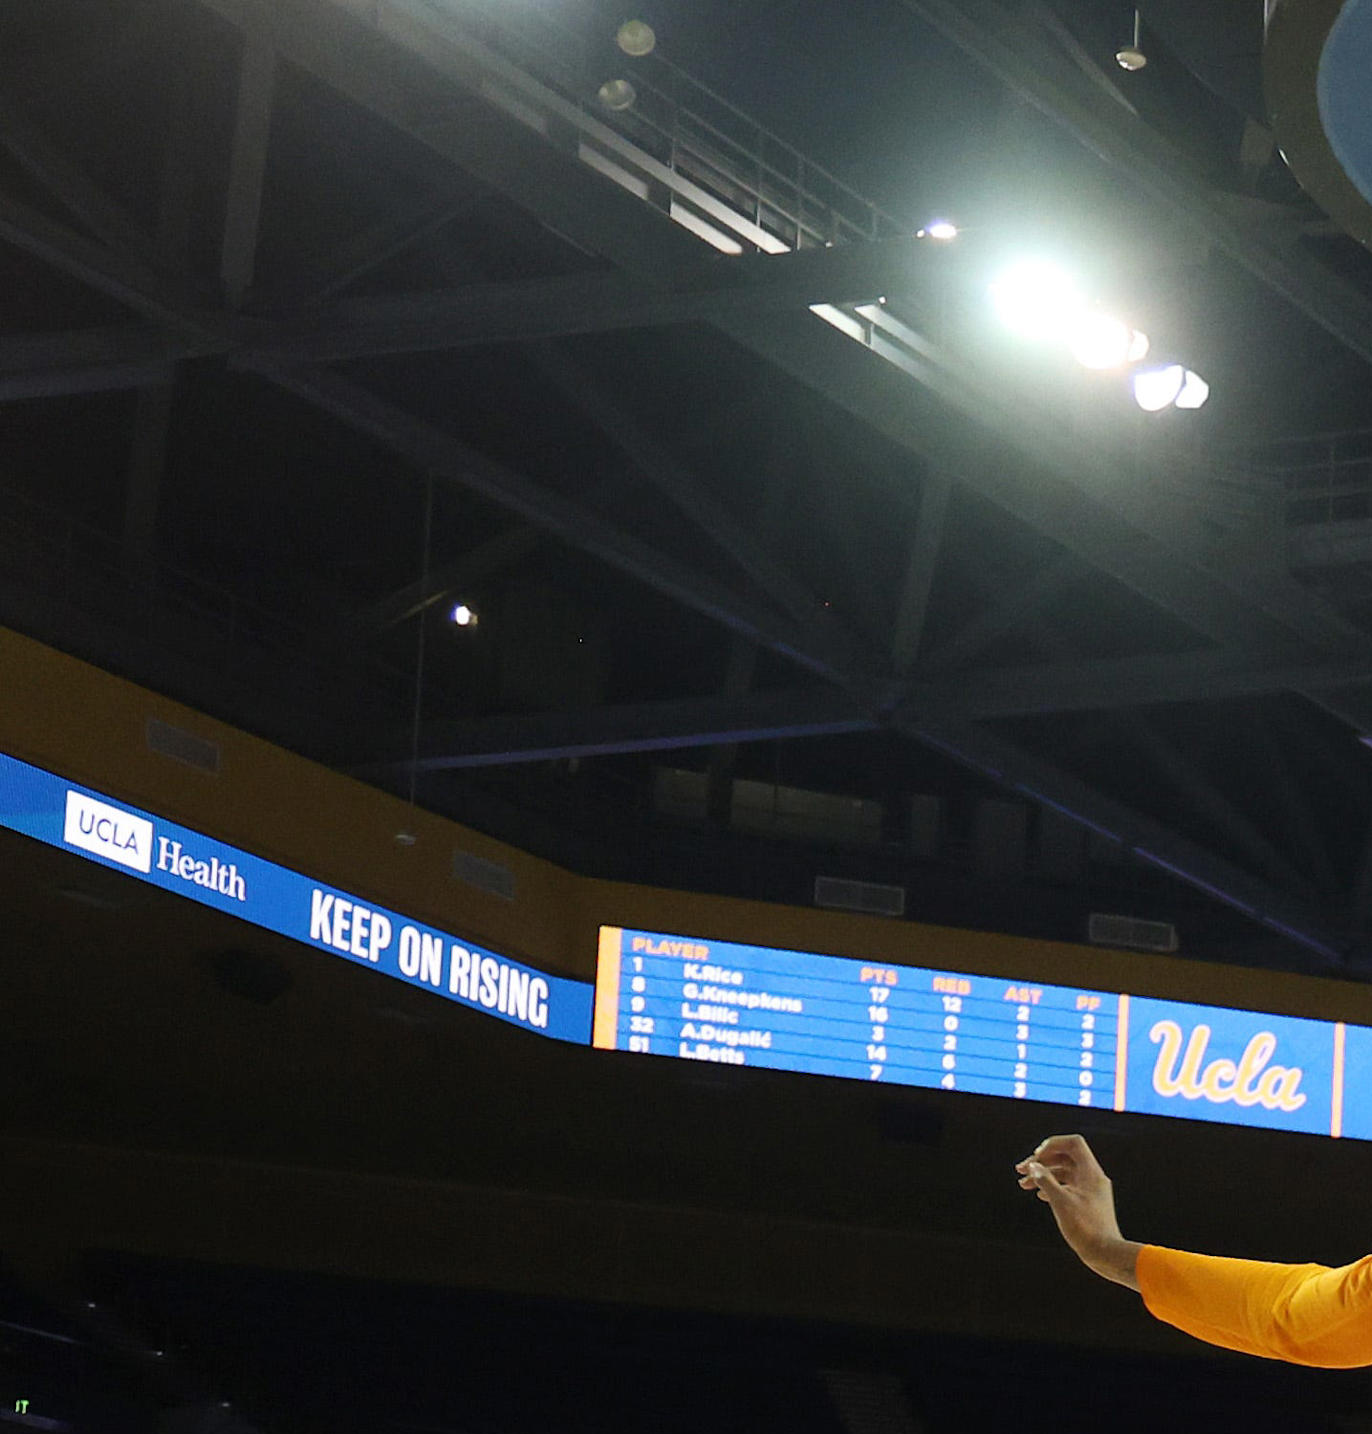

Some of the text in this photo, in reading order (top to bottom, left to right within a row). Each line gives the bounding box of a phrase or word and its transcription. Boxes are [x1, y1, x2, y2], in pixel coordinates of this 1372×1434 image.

[78, 808, 246, 901] UCLA Health
[311, 889, 548, 1028] KEEP ON RISING
[632, 937, 709, 960] PLAYER
[860, 967, 898, 985] PTS
[933, 977, 971, 995] REB
[1003, 986, 1042, 1004] AST
[633, 957, 1095, 1030] 1 K.Rice 17 12 2 2
[631, 996, 645, 1012] 9
[872, 1026, 885, 1041] 3
[944, 1035, 957, 1050] 2
[1017, 1044, 1027, 1059] 1
[632, 976, 646, 992] 8
[869, 1006, 888, 1022] 16
[944, 1015, 958, 1031] 0
[1016, 1025, 1029, 1040] 3
[1081, 1033, 1094, 1049] 3
[630, 1016, 653, 1033] 32
[867, 1045, 887, 1061] 14
[1014, 1063, 1027, 1079] 2
[1079, 1071, 1093, 1086] 0
[680, 1042, 744, 1065] L.Betts
[870, 1065, 882, 1080] 7
[942, 1074, 955, 1089] 4
[1014, 1082, 1026, 1098] 3
[1149, 1019, 1307, 1112] Ucla
